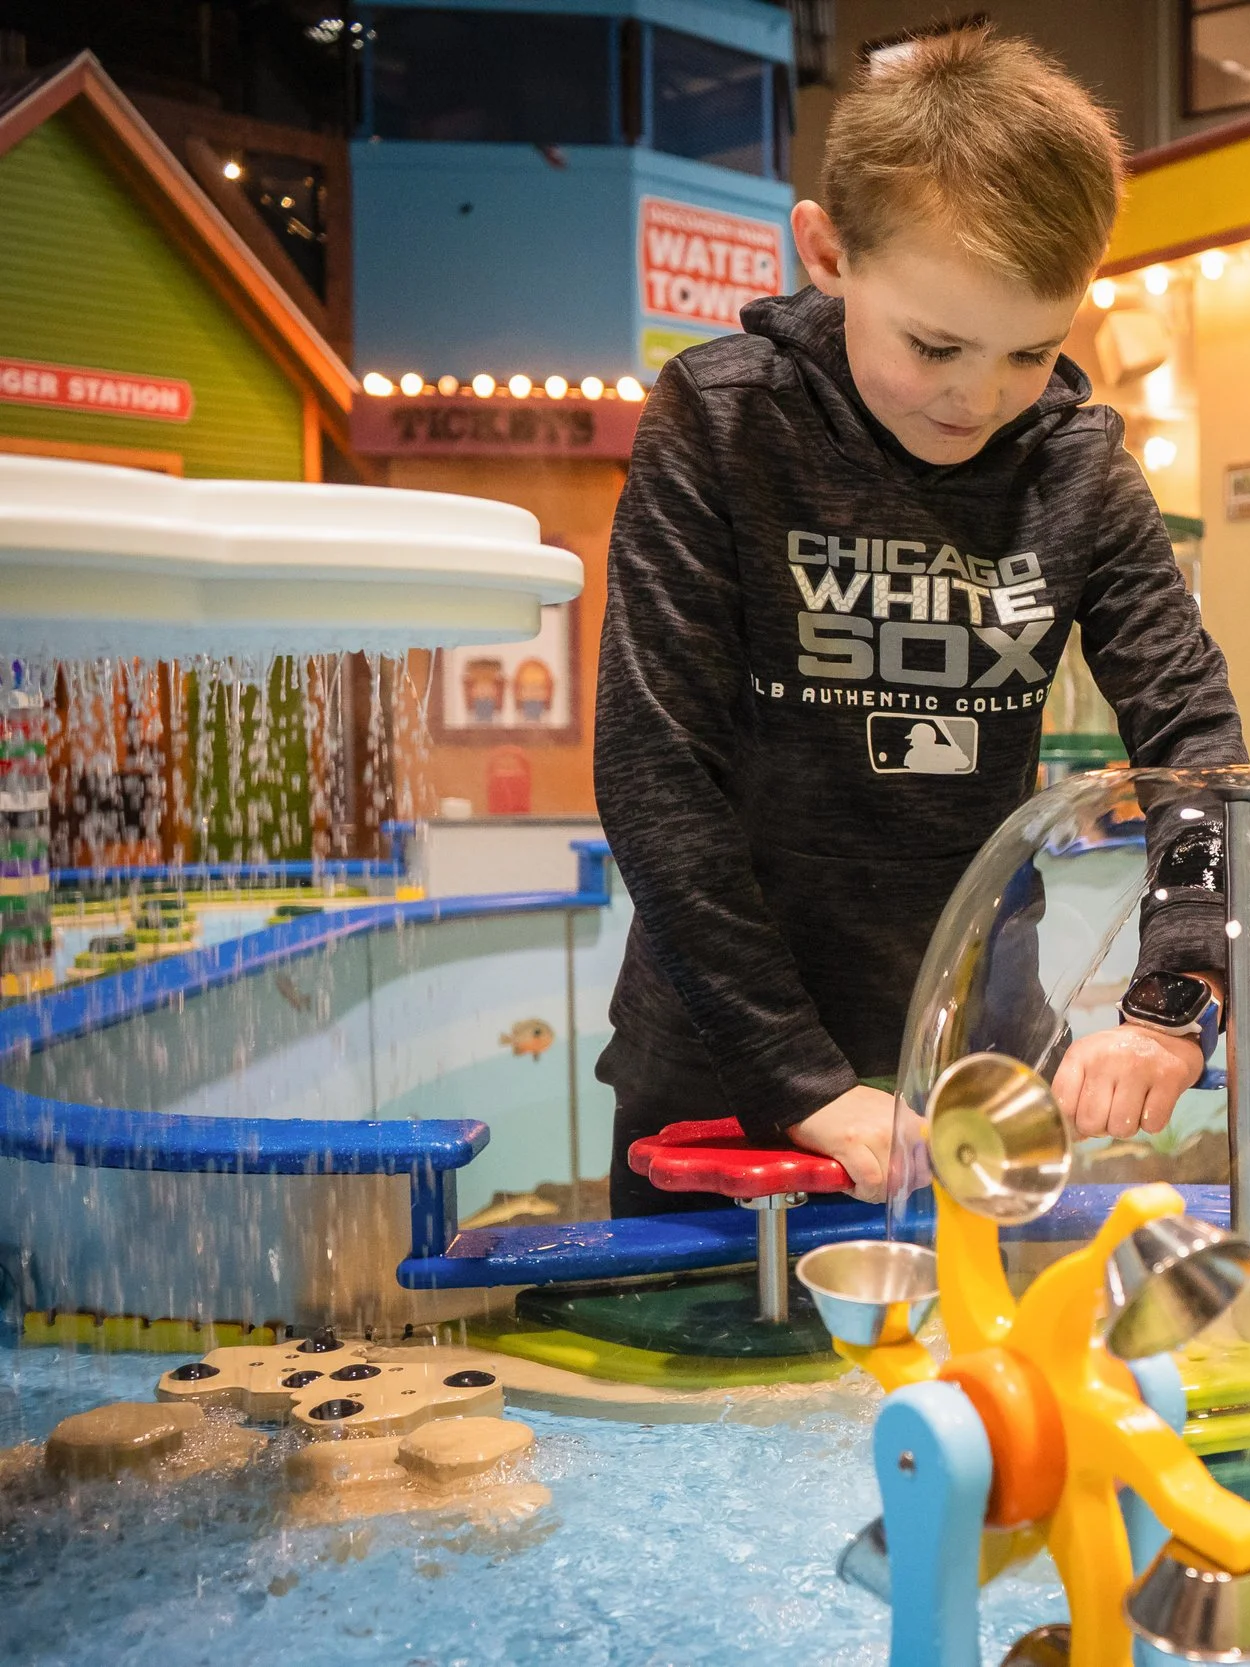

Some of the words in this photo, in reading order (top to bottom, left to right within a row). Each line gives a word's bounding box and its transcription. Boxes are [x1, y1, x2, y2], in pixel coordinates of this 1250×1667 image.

[649, 227, 777, 289] WATER
[649, 270, 775, 322] TOWE
[0, 367, 58, 398] GER
[68, 376, 180, 414] STATION
[393, 406, 594, 446] TICKETS
[788, 530, 1042, 587] CHICAGO
[789, 564, 1055, 626] WHITE
[797, 610, 1055, 688] SOX
[750, 673, 785, 699] LB
[802, 687, 938, 711] AUTHENTIC
